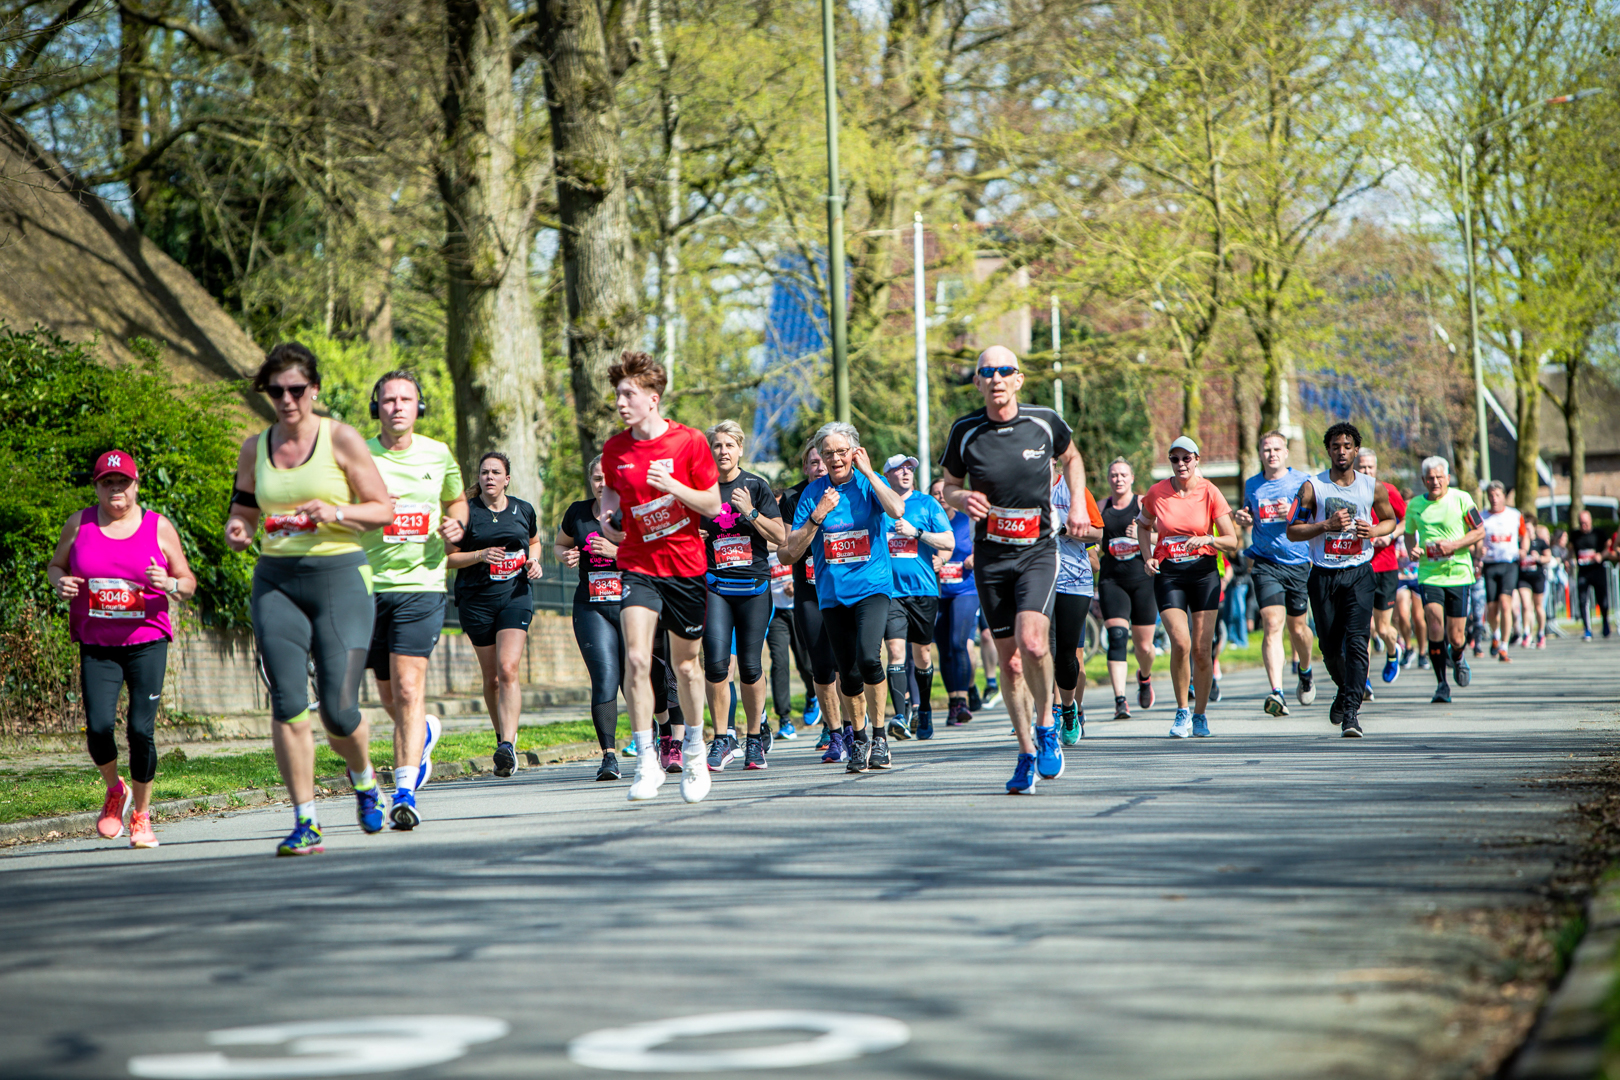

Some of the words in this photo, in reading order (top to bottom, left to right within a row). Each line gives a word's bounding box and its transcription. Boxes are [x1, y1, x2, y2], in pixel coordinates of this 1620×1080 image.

[393, 515, 423, 527] 4213
[643, 508, 670, 527] 5195
[650, 519, 672, 532] Patrick
[997, 519, 1025, 531] 5266
[831, 540, 856, 551] 4301
[889, 540, 907, 548] 3057
[721, 545, 743, 556] 3343
[497, 560, 517, 569] 4131
[595, 580, 618, 589] 3345
[99, 590, 129, 603] 3046
